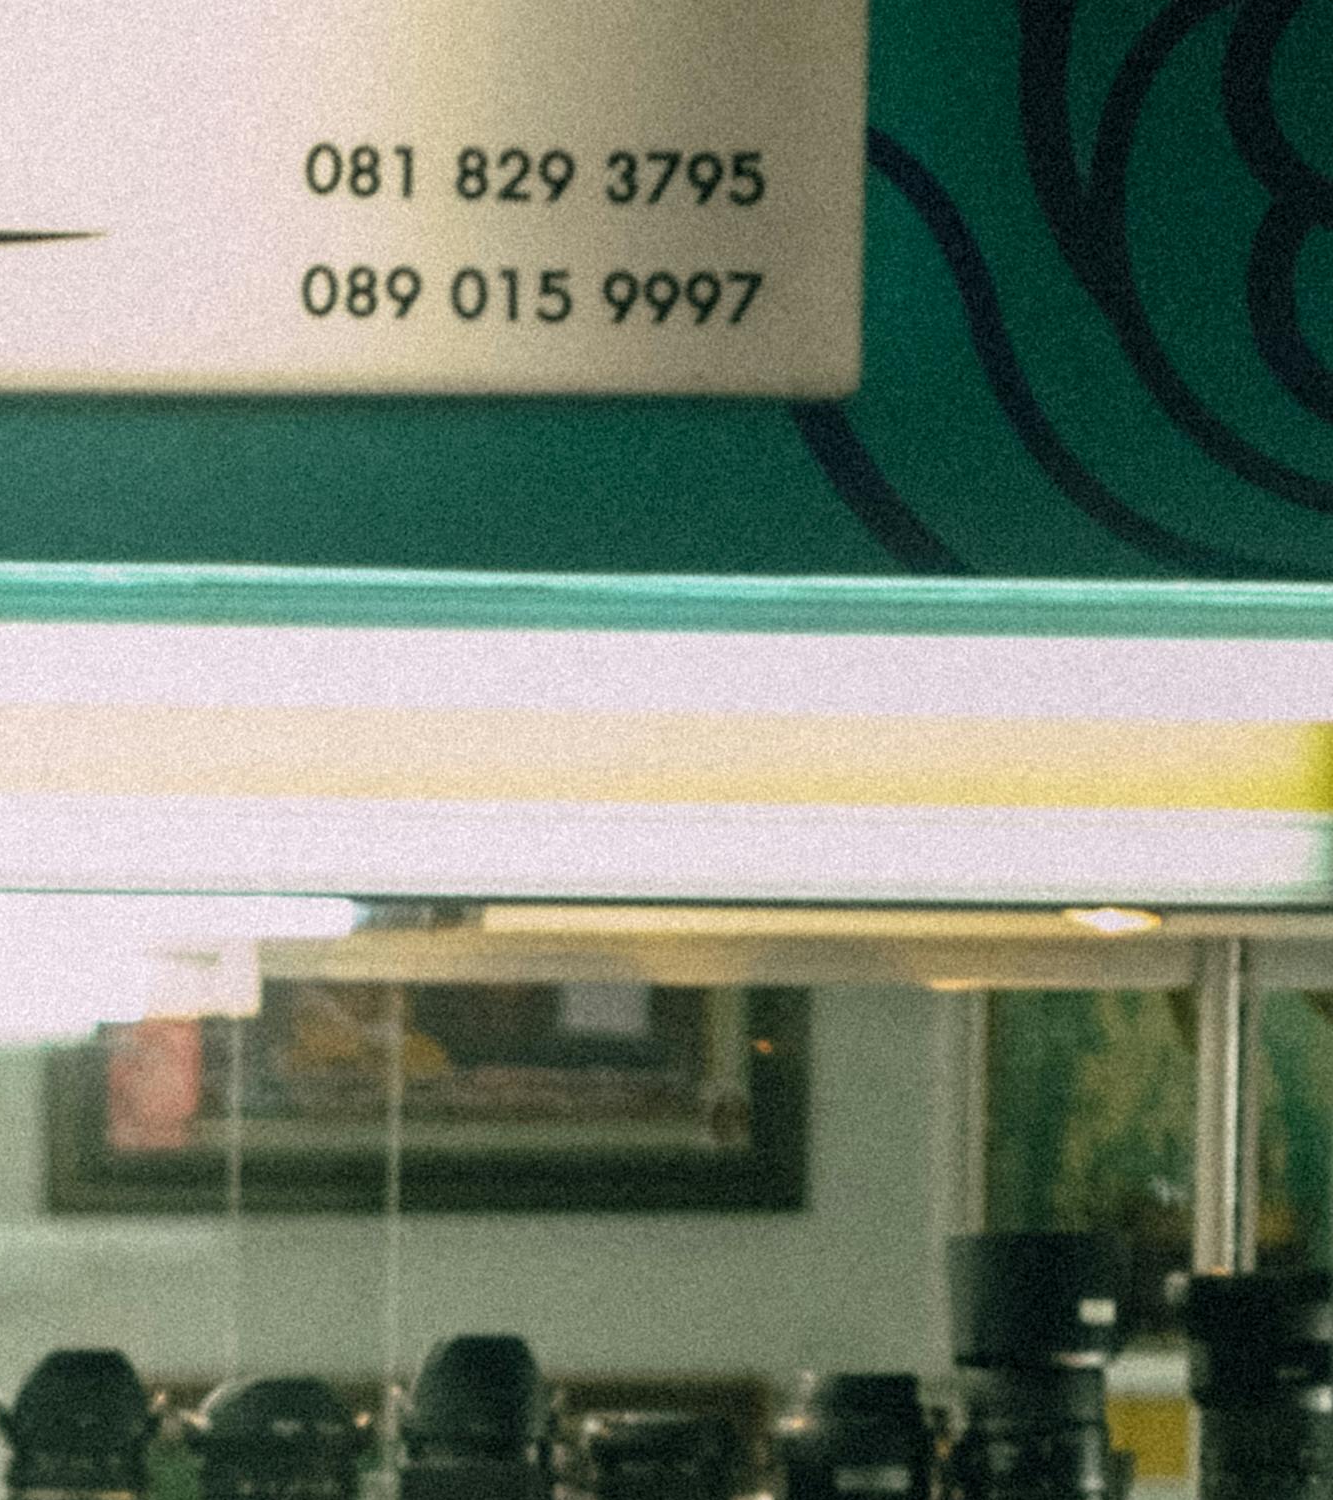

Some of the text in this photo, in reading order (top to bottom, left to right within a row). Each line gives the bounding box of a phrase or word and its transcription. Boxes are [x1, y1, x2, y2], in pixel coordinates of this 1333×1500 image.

[304, 141, 767, 206] 081 829 3795
[301, 264, 765, 325] 089 015 9997
